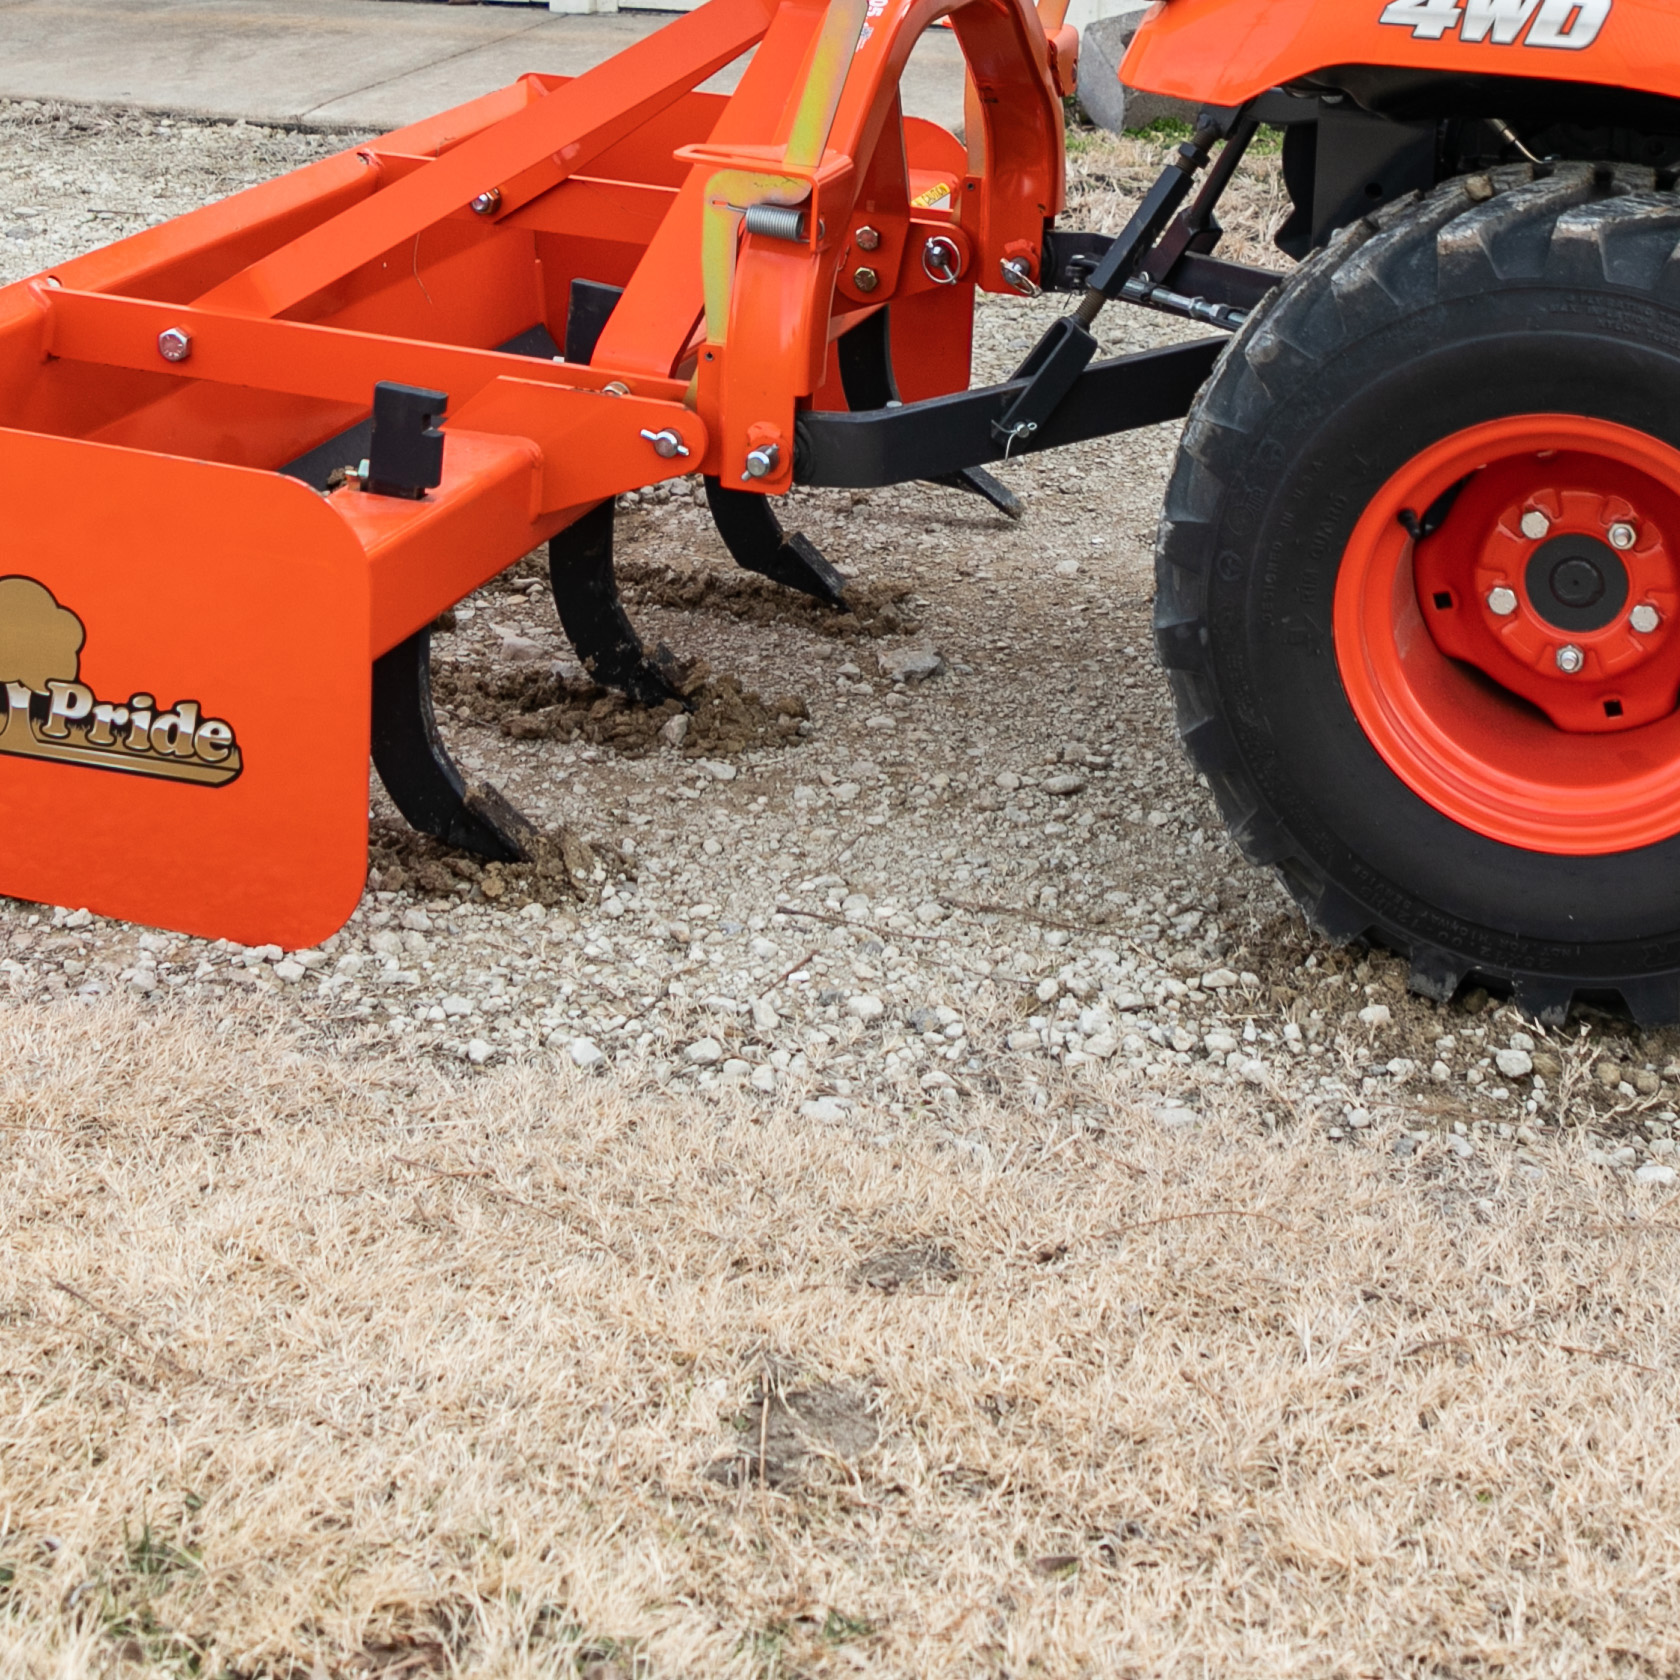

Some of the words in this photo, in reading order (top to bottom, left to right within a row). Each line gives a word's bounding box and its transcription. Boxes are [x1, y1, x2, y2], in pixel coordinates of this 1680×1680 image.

[1304, 490, 1349, 561] GUARD
[1297, 565, 1321, 603] RIM
[45, 680, 234, 762] Pride
